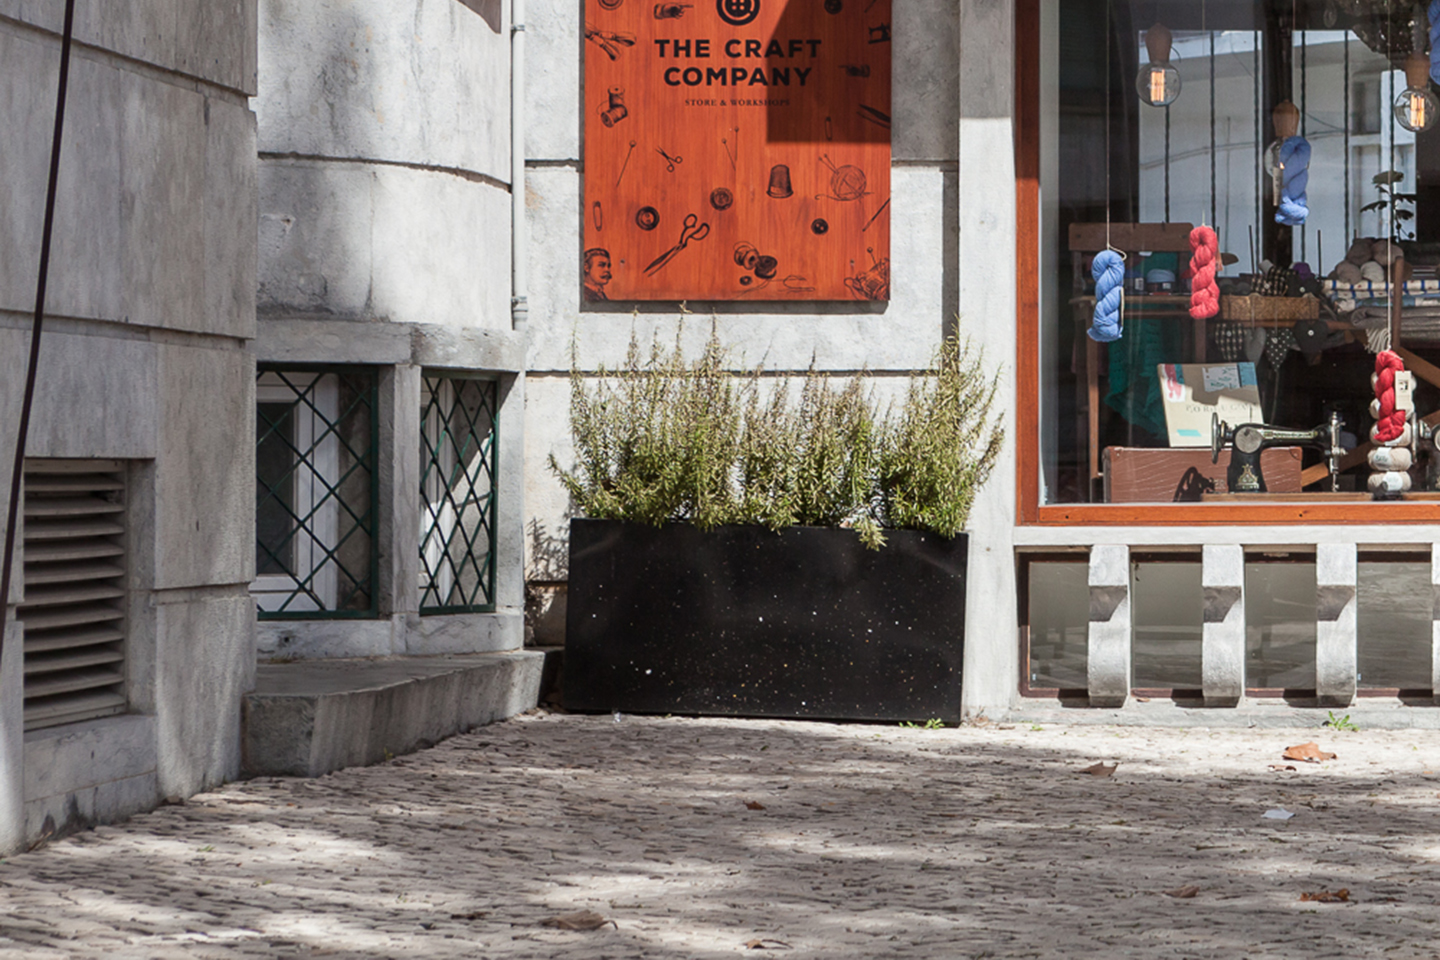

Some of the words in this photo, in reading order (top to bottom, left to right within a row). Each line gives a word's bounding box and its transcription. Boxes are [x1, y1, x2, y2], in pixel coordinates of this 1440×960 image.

[654, 39, 710, 58] THE
[725, 39, 822, 58] CRAFT
[664, 67, 812, 86] COMPANY
